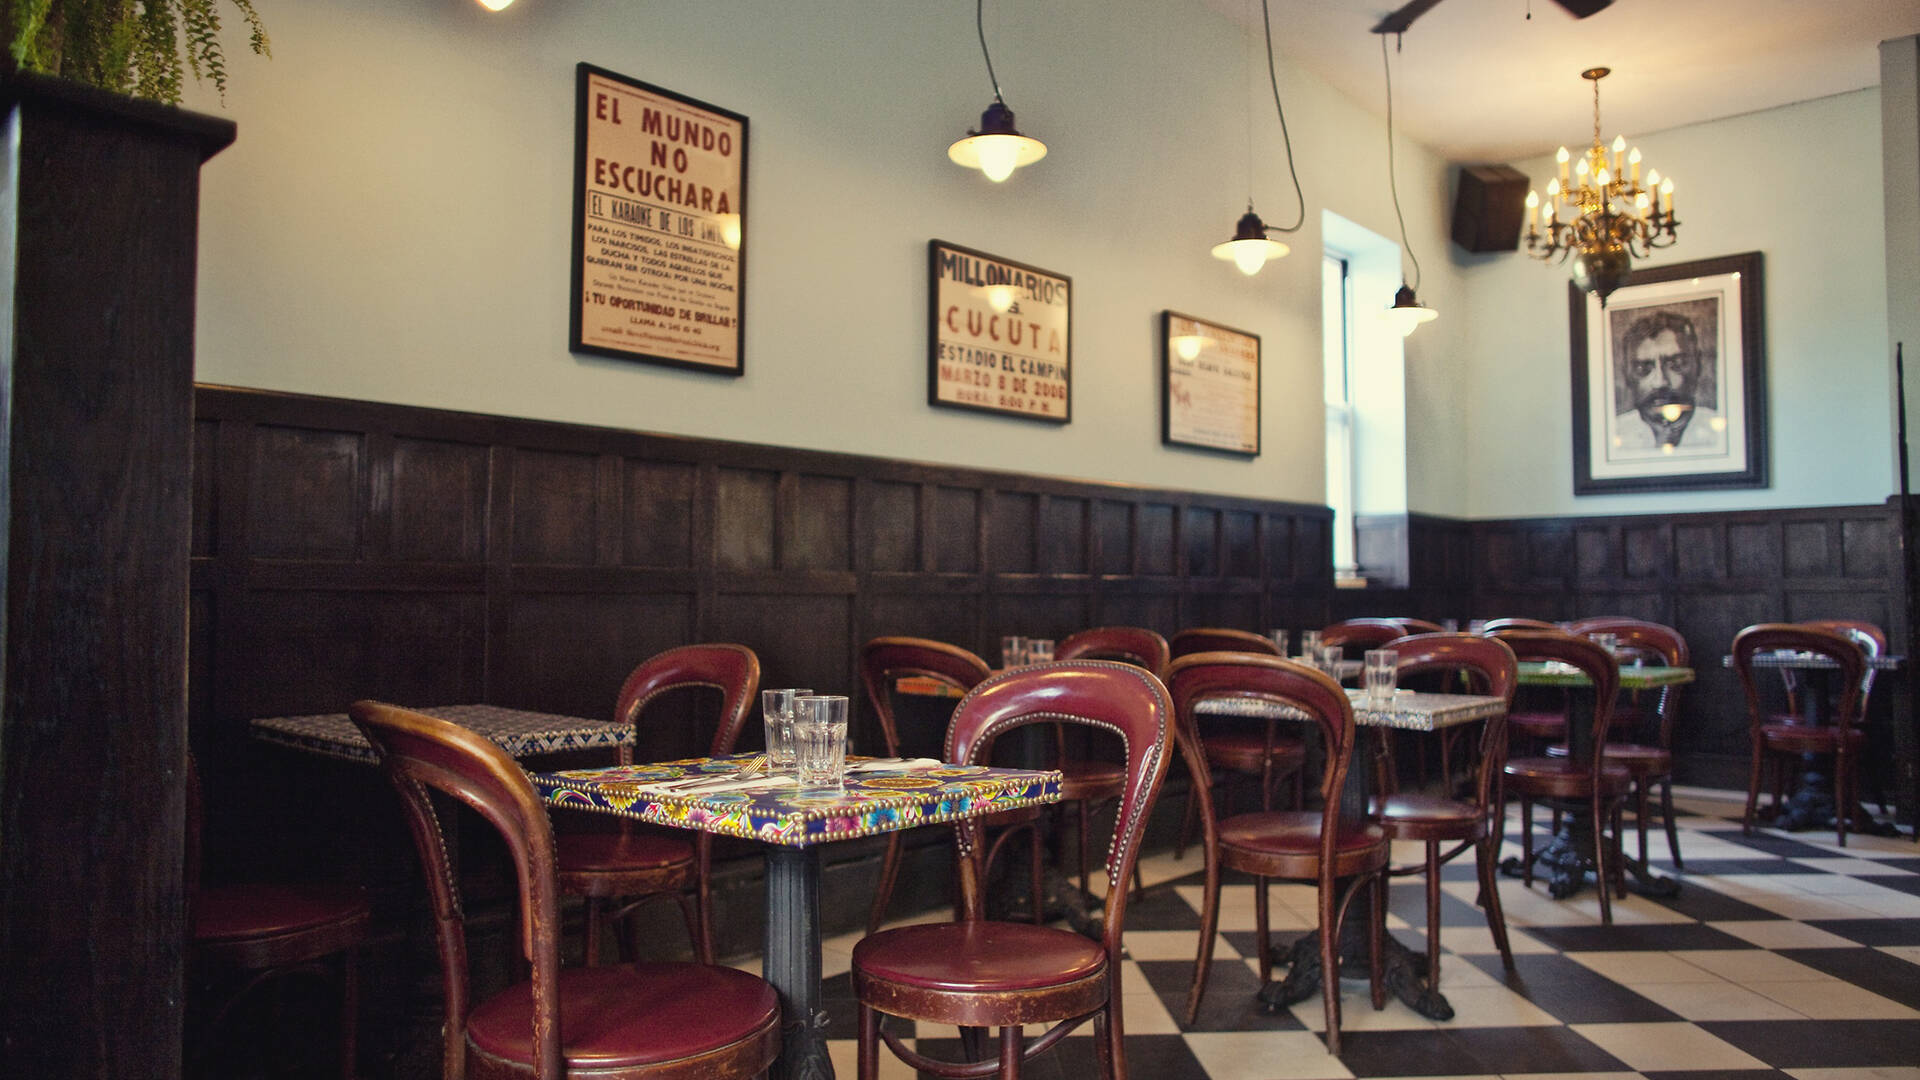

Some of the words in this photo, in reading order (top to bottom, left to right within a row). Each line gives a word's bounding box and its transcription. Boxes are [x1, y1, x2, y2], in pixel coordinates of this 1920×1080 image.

[596, 93, 621, 125] EL
[641, 107, 732, 158] MUNDO
[651, 140, 689, 174] NO
[594, 157, 731, 215] ESCUCHARA
[593, 194, 603, 217] EL
[611, 199, 652, 228] KARAOKE
[659, 211, 671, 233] DE
[678, 215, 695, 238] LOS
[587, 223, 610, 234] PARA
[612, 229, 626, 239] LOS
[665, 241, 680, 251] LOS
[592, 235, 607, 245] LOS
[653, 249, 668, 259] LAS
[670, 252, 708, 267] ESTRELLAS
[586, 255, 623, 269] QUIERAN
[624, 263, 638, 273] SER
[674, 273, 689, 283] POR
[691, 278, 707, 288] UNA
[601, 248, 630, 260] DUCHA
[633, 254, 638, 262] Y
[641, 256, 666, 269] TODOS
[669, 264, 707, 278] AQUELLOS
[708, 271, 723, 281] QUE
[938, 250, 1067, 307] MILLONARIOS
[592, 292, 606, 306] TU
[609, 295, 676, 318] OPORTUNIDAD
[679, 308, 692, 321] DE
[946, 305, 1062, 355] CUCUTA
[938, 343, 997, 369] ESTADIO
[1001, 355, 1016, 373] EL
[940, 365, 992, 388] MARZO
[1012, 377, 1028, 394] DE
